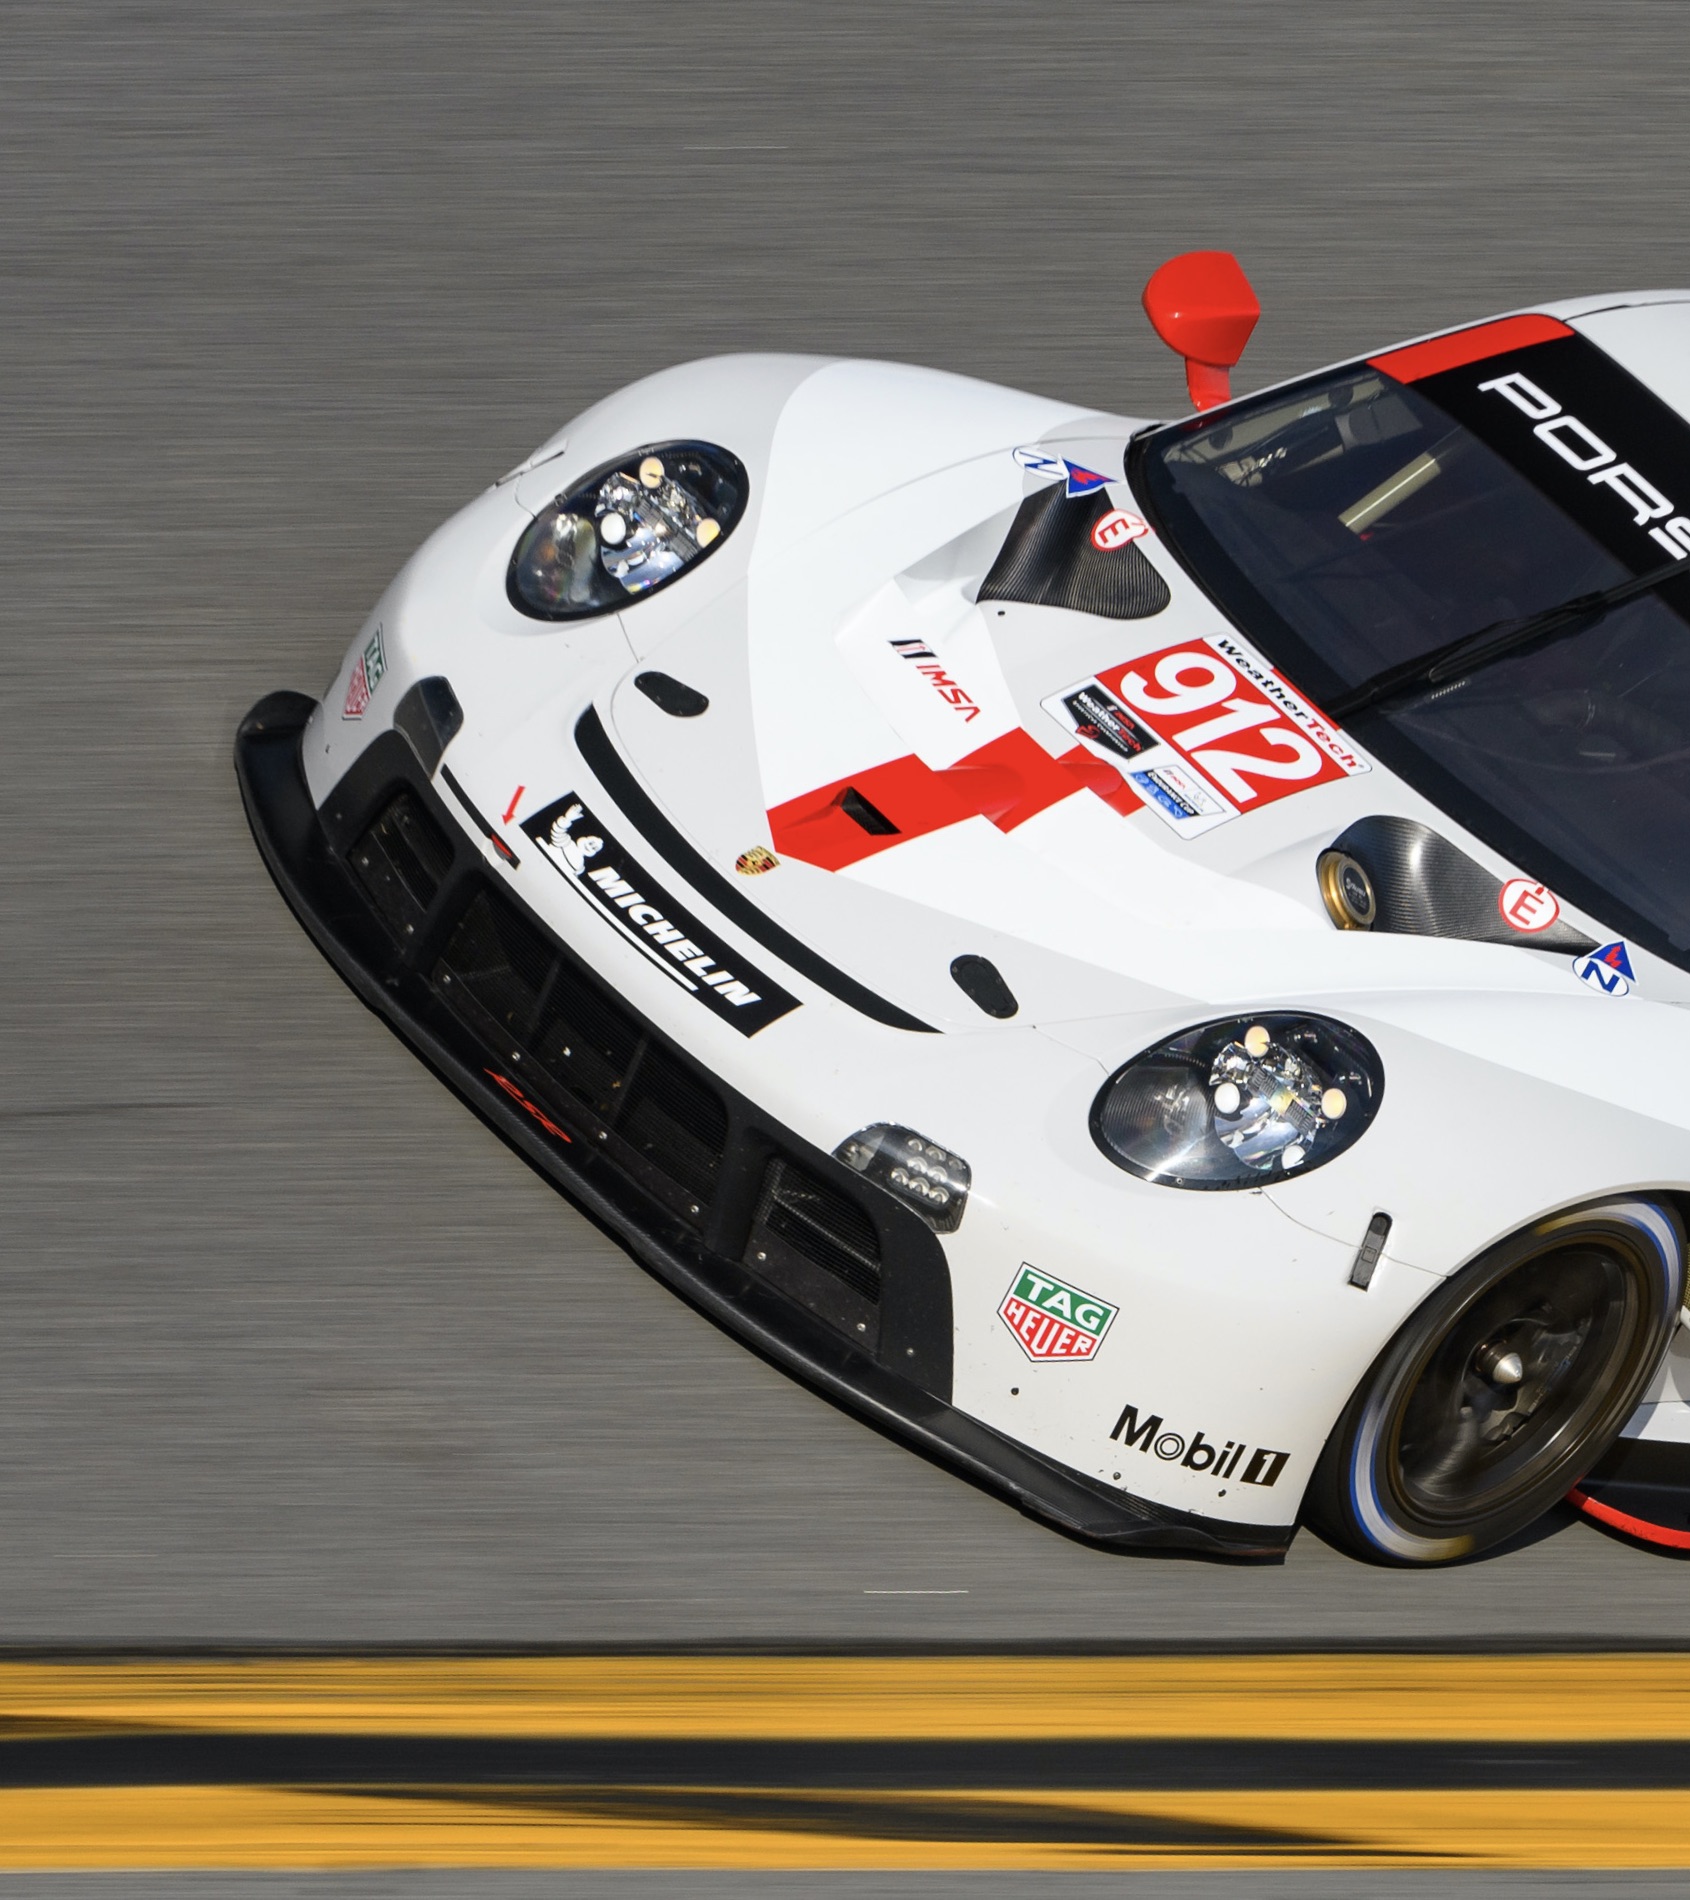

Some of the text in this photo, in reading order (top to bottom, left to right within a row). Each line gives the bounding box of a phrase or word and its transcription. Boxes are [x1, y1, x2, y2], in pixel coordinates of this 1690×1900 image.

[1098, 518, 1130, 545] E
[915, 664, 981, 723] IMSA
[1120, 651, 1323, 804] 912
[587, 866, 762, 1007] MICHELIN
[1509, 889, 1545, 926] E
[1006, 1300, 1093, 1355] HEUER
[1026, 1273, 1105, 1332] TAG
[1109, 1403, 1247, 1480] Mobil
